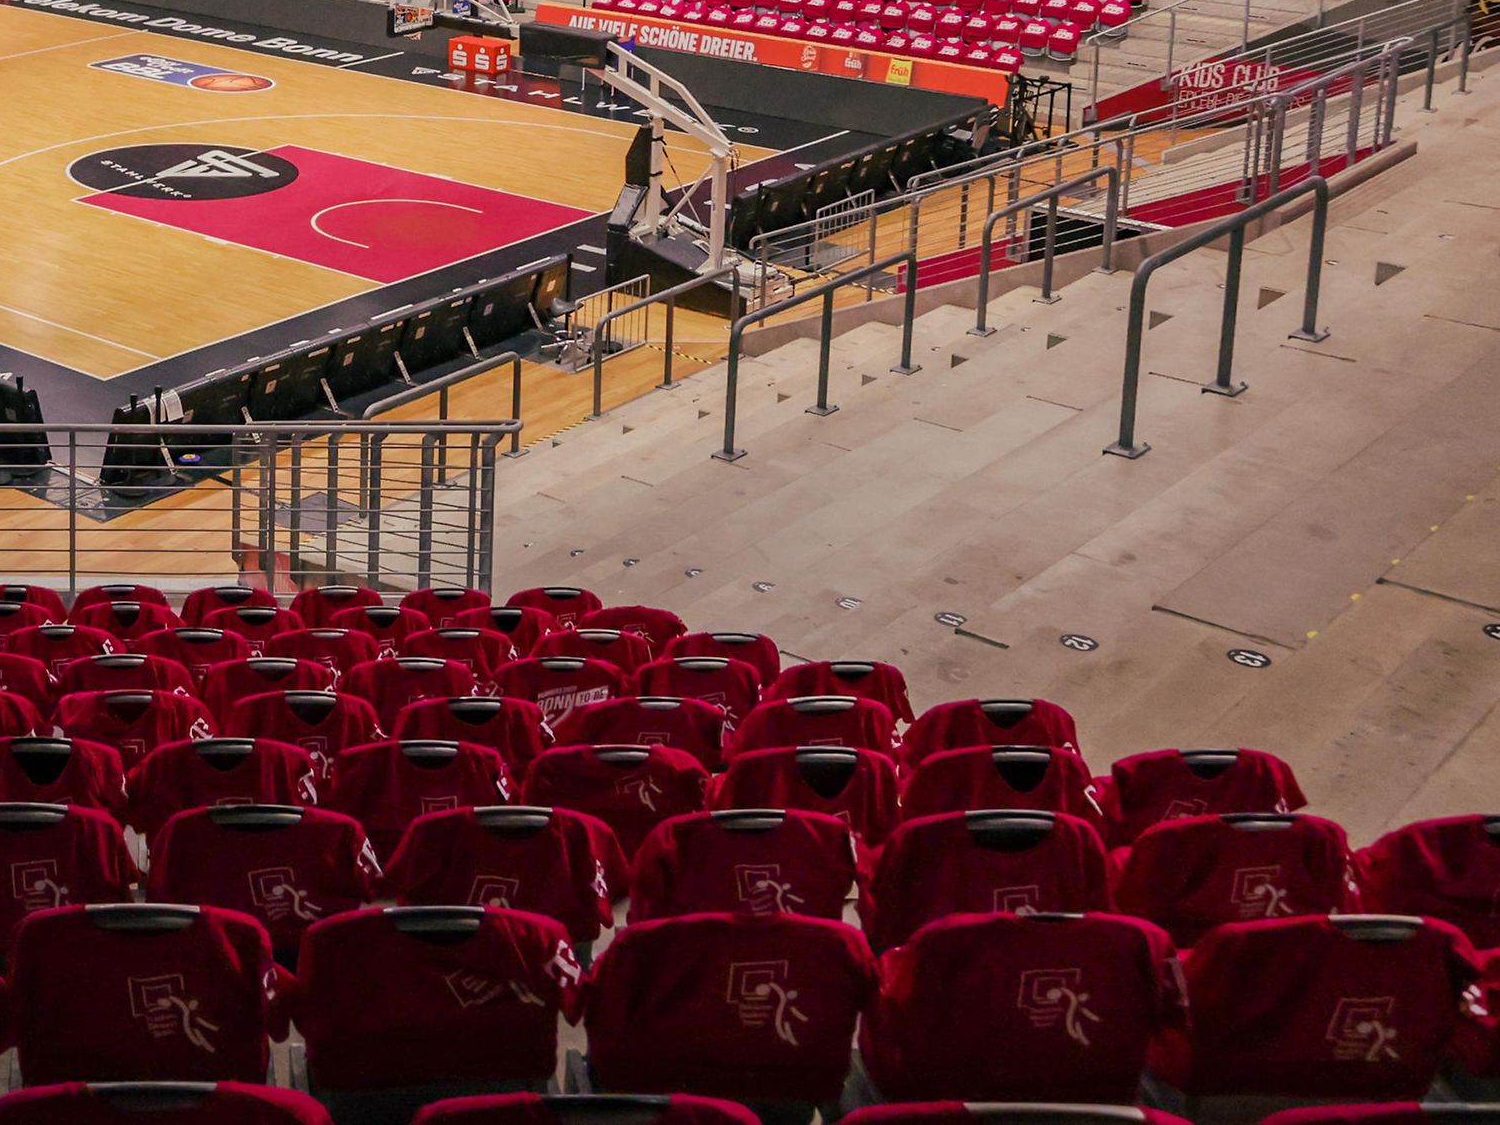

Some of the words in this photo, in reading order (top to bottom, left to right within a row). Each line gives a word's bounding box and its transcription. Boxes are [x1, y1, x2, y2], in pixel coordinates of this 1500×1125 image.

[144, 17, 257, 44] Dome
[252, 37, 364, 63] Bonn
[638, 25, 698, 53] SCHÖNE
[699, 34, 759, 62] DREIER.
[1178, 63, 1226, 89] KIDS
[1231, 64, 1281, 92] CLUB
[100, 159, 185, 198] STAHLWERK
[1063, 635, 1094, 651] 12
[1233, 650, 1268, 668] 13
